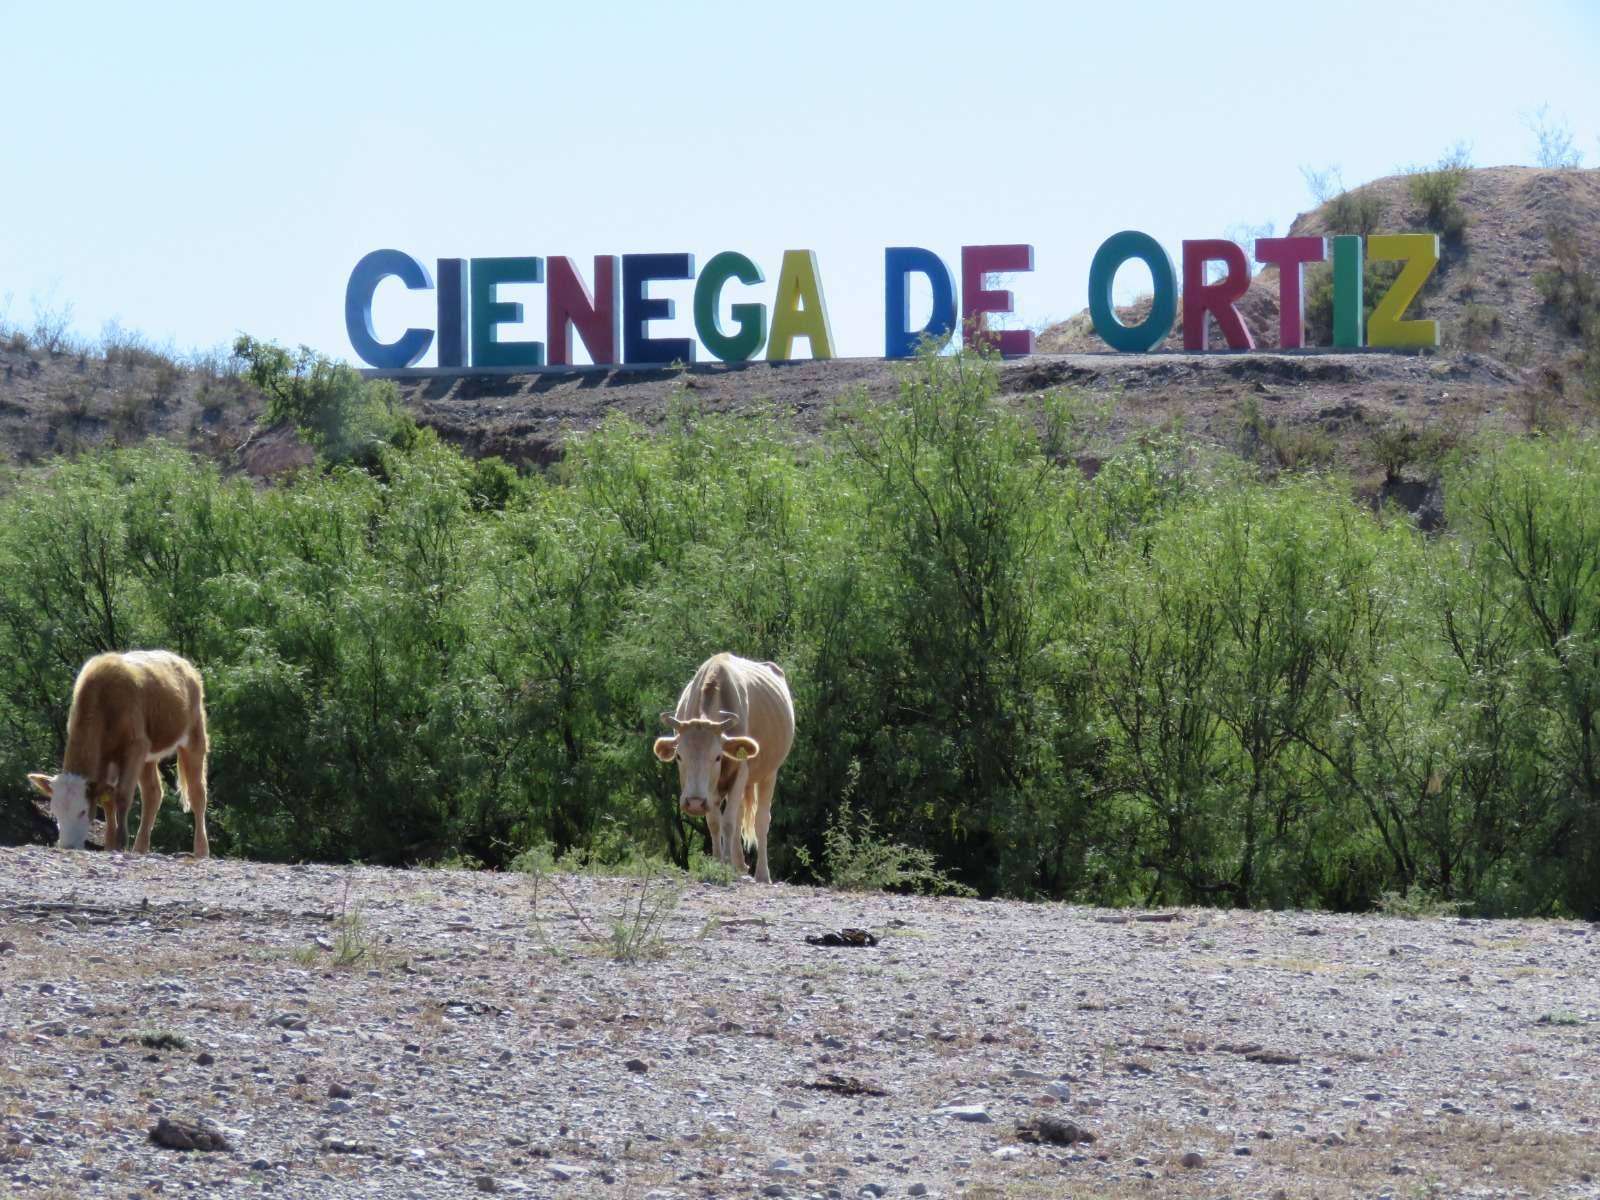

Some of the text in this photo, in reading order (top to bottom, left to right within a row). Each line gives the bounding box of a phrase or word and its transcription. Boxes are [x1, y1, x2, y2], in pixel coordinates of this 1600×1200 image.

[345, 230, 1441, 369] CIENEGA DE ORTIZ
